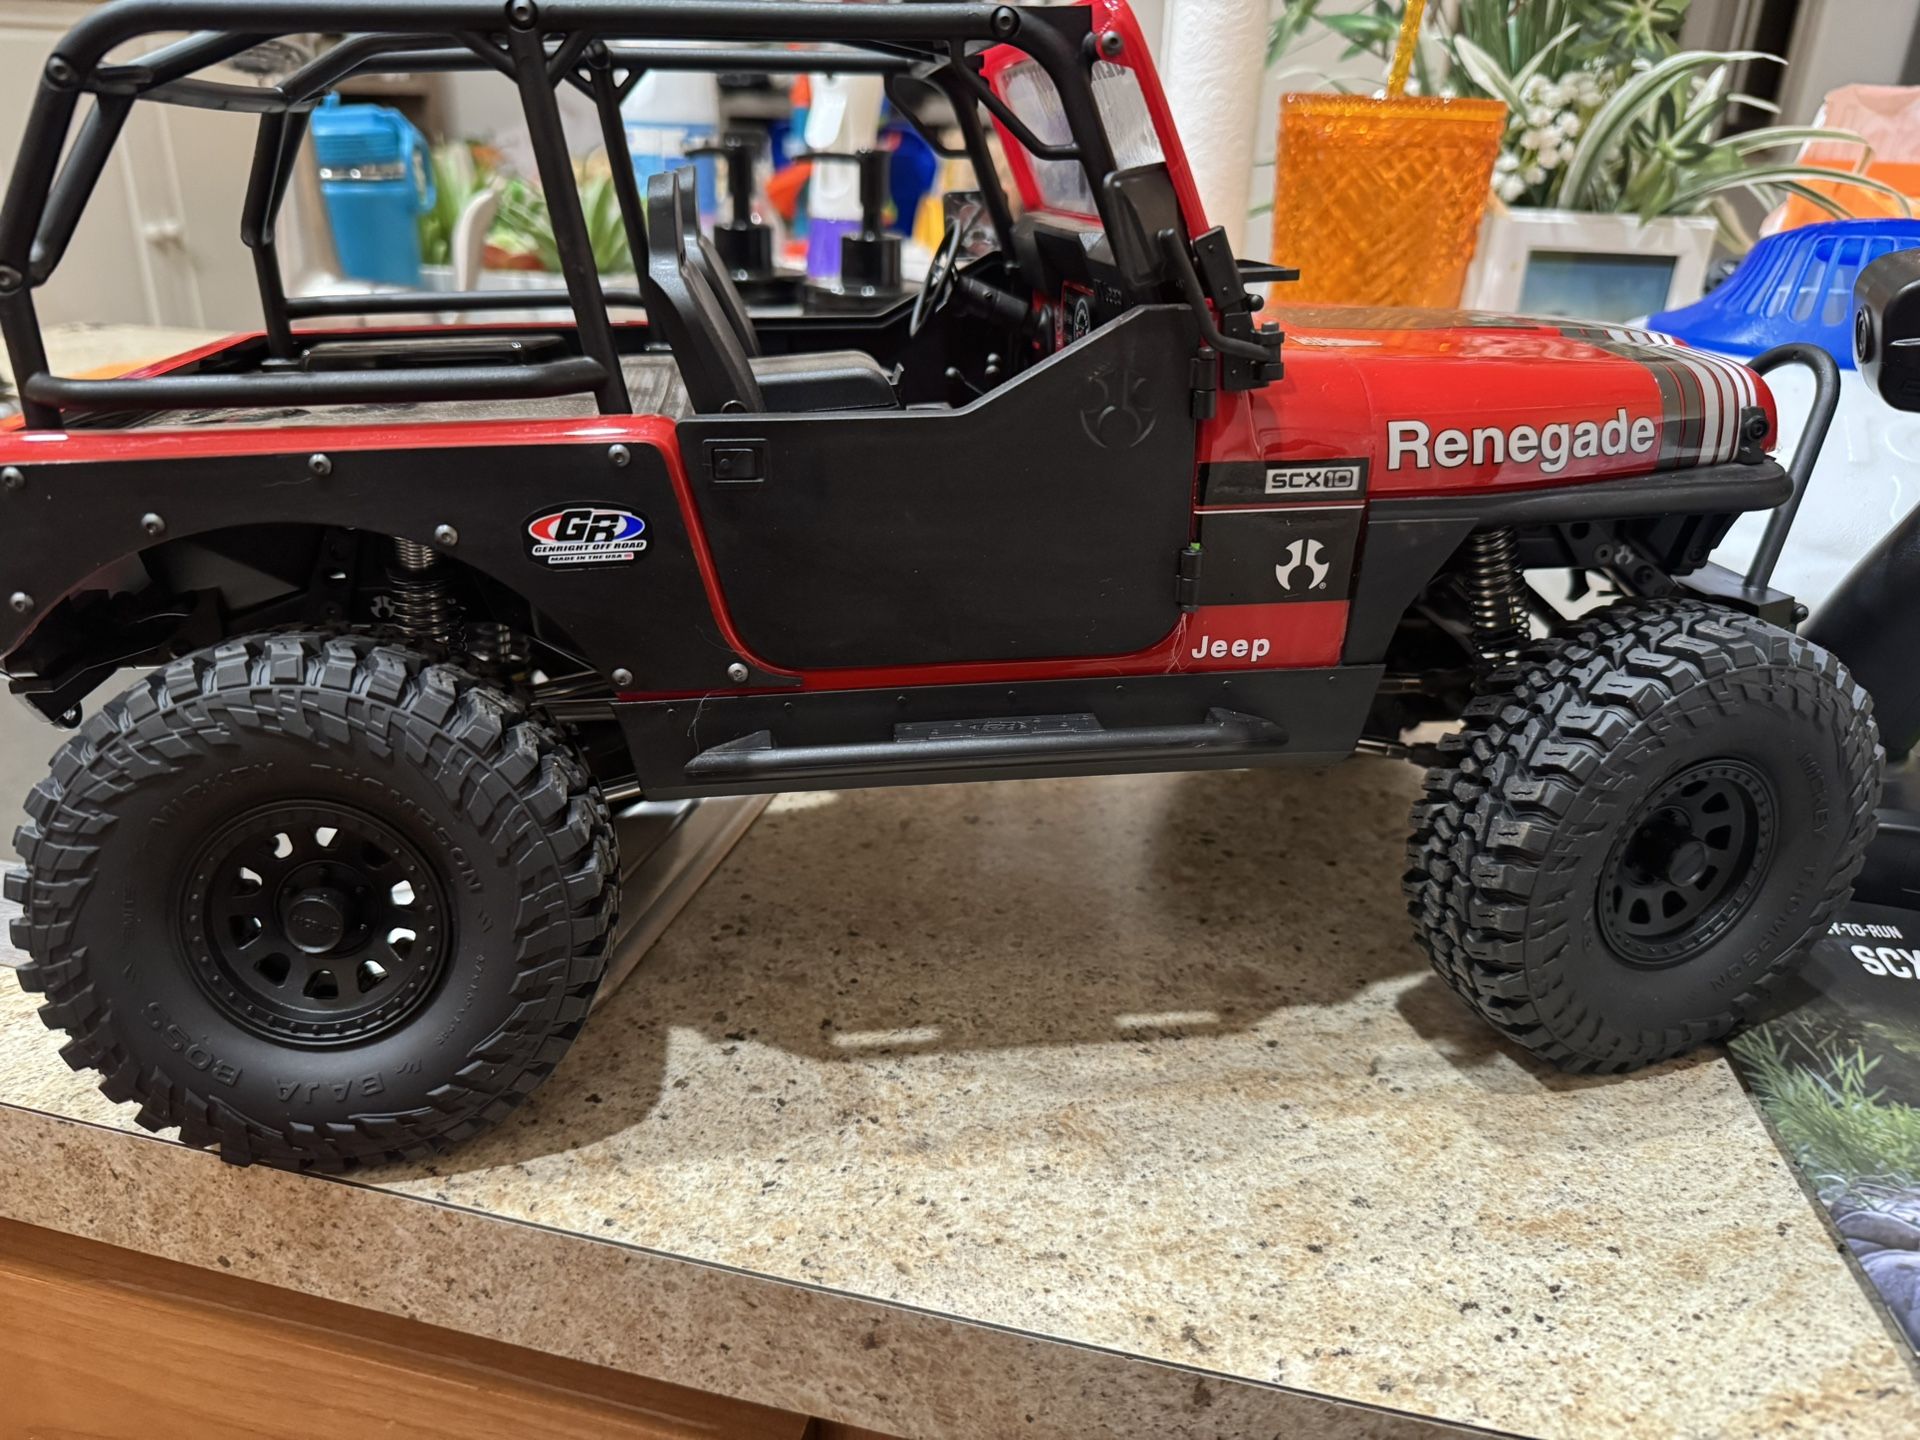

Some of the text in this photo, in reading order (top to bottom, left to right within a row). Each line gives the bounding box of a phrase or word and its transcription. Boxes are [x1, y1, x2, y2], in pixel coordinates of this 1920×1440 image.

[1386, 407, 1656, 473] Renegade
[1271, 468, 1354, 489] SCX10
[555, 509, 620, 542] GR
[533, 541, 645, 554] GENRIGHT OFF ROAD
[1191, 635, 1270, 662] Jeep
[1827, 922, 1903, 940] Y-TO-RUN
[142, 1001, 386, 1104] BAJA BOSS
